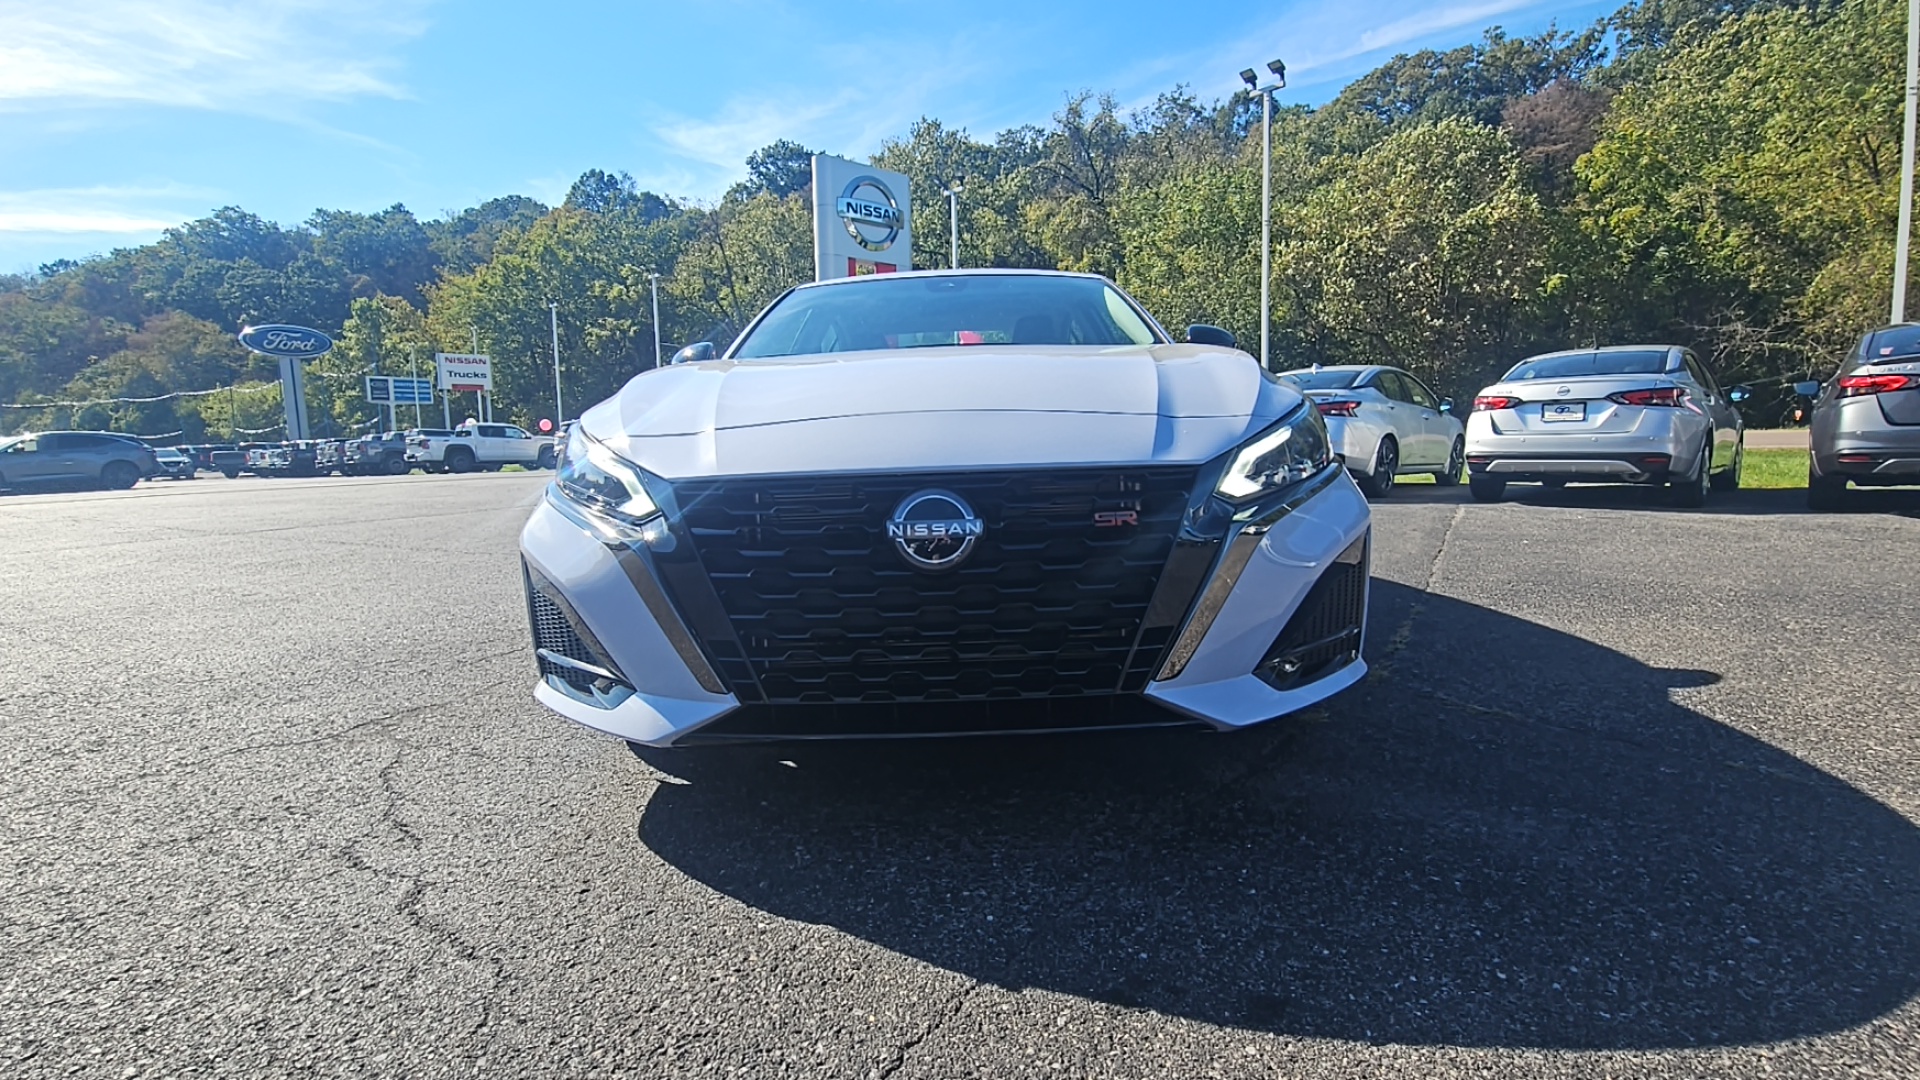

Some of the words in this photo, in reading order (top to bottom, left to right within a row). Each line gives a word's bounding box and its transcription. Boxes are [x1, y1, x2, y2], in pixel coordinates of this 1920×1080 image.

[846, 202, 900, 222] NISSAN
[263, 331, 317, 351] Ford
[444, 356, 487, 365] NISSAN
[446, 370, 487, 379] Trucks
[1094, 511, 1138, 527] SR
[889, 521, 981, 537] NISSAN
